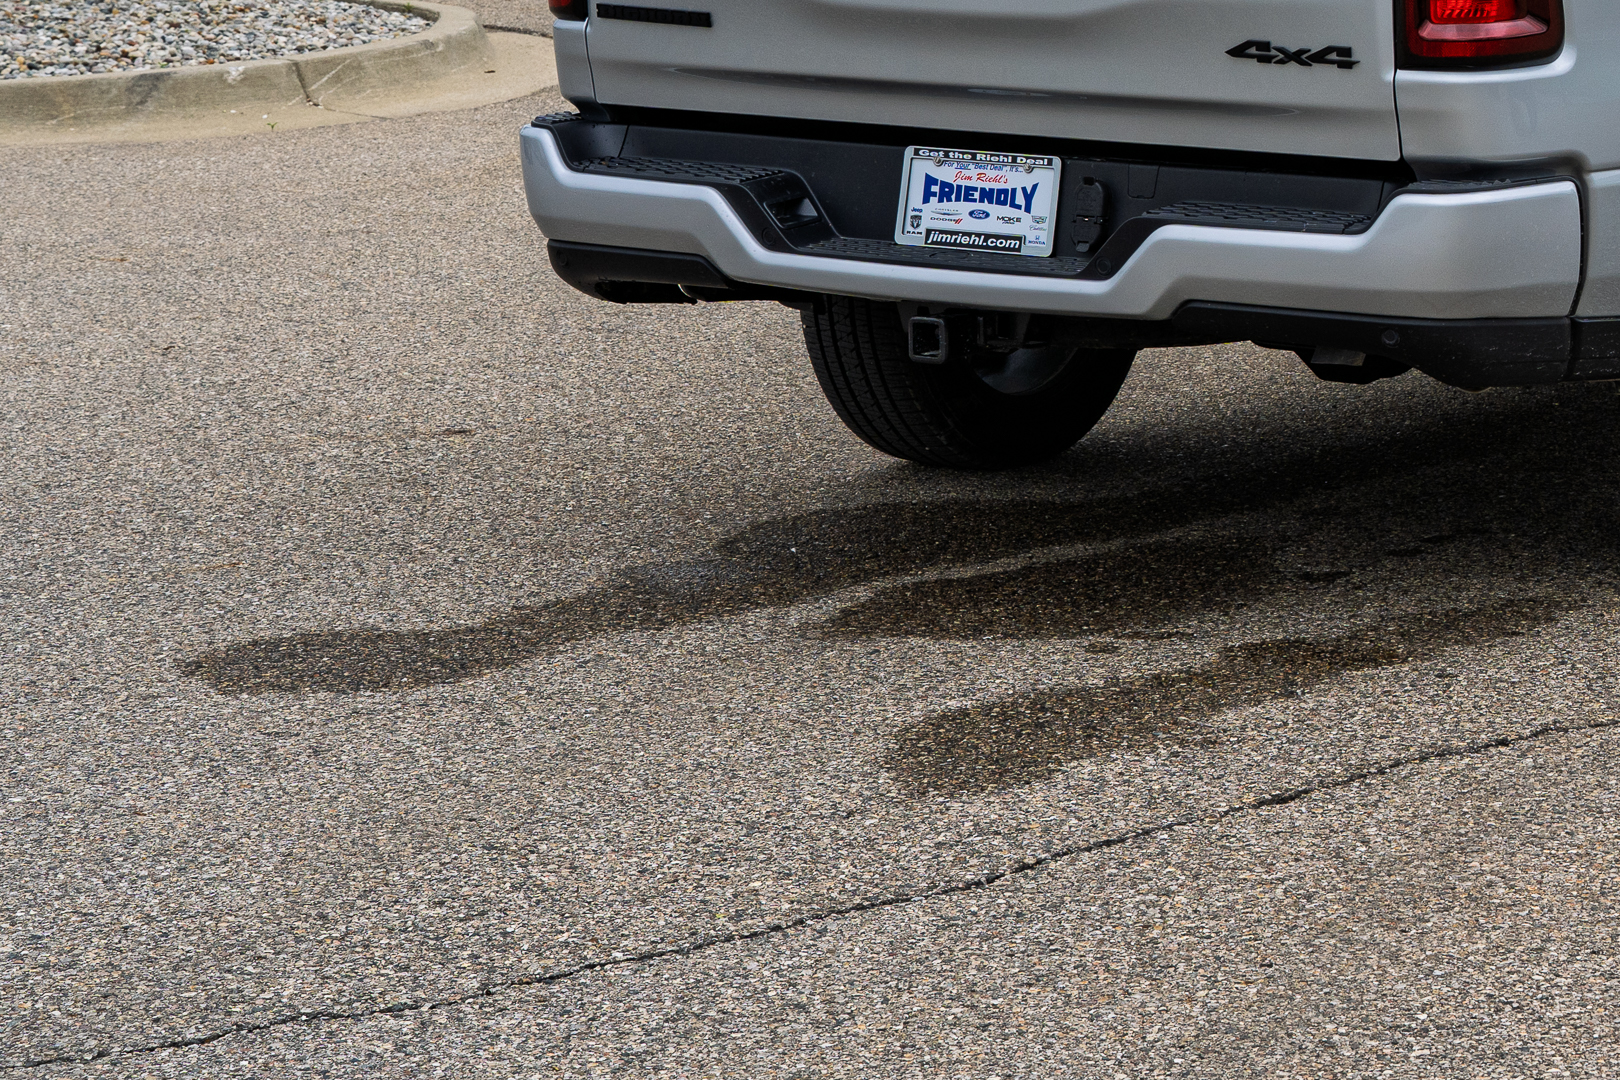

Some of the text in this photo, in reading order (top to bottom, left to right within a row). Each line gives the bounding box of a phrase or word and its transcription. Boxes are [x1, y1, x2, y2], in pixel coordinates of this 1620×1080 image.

[1224, 39, 1361, 70] 4x4
[918, 149, 1048, 165] Get the Riehl Deal
[952, 170, 1009, 184] Jim Riehl's
[921, 172, 1040, 215] FRIENDLY
[927, 231, 1020, 249] jimriehl.com
